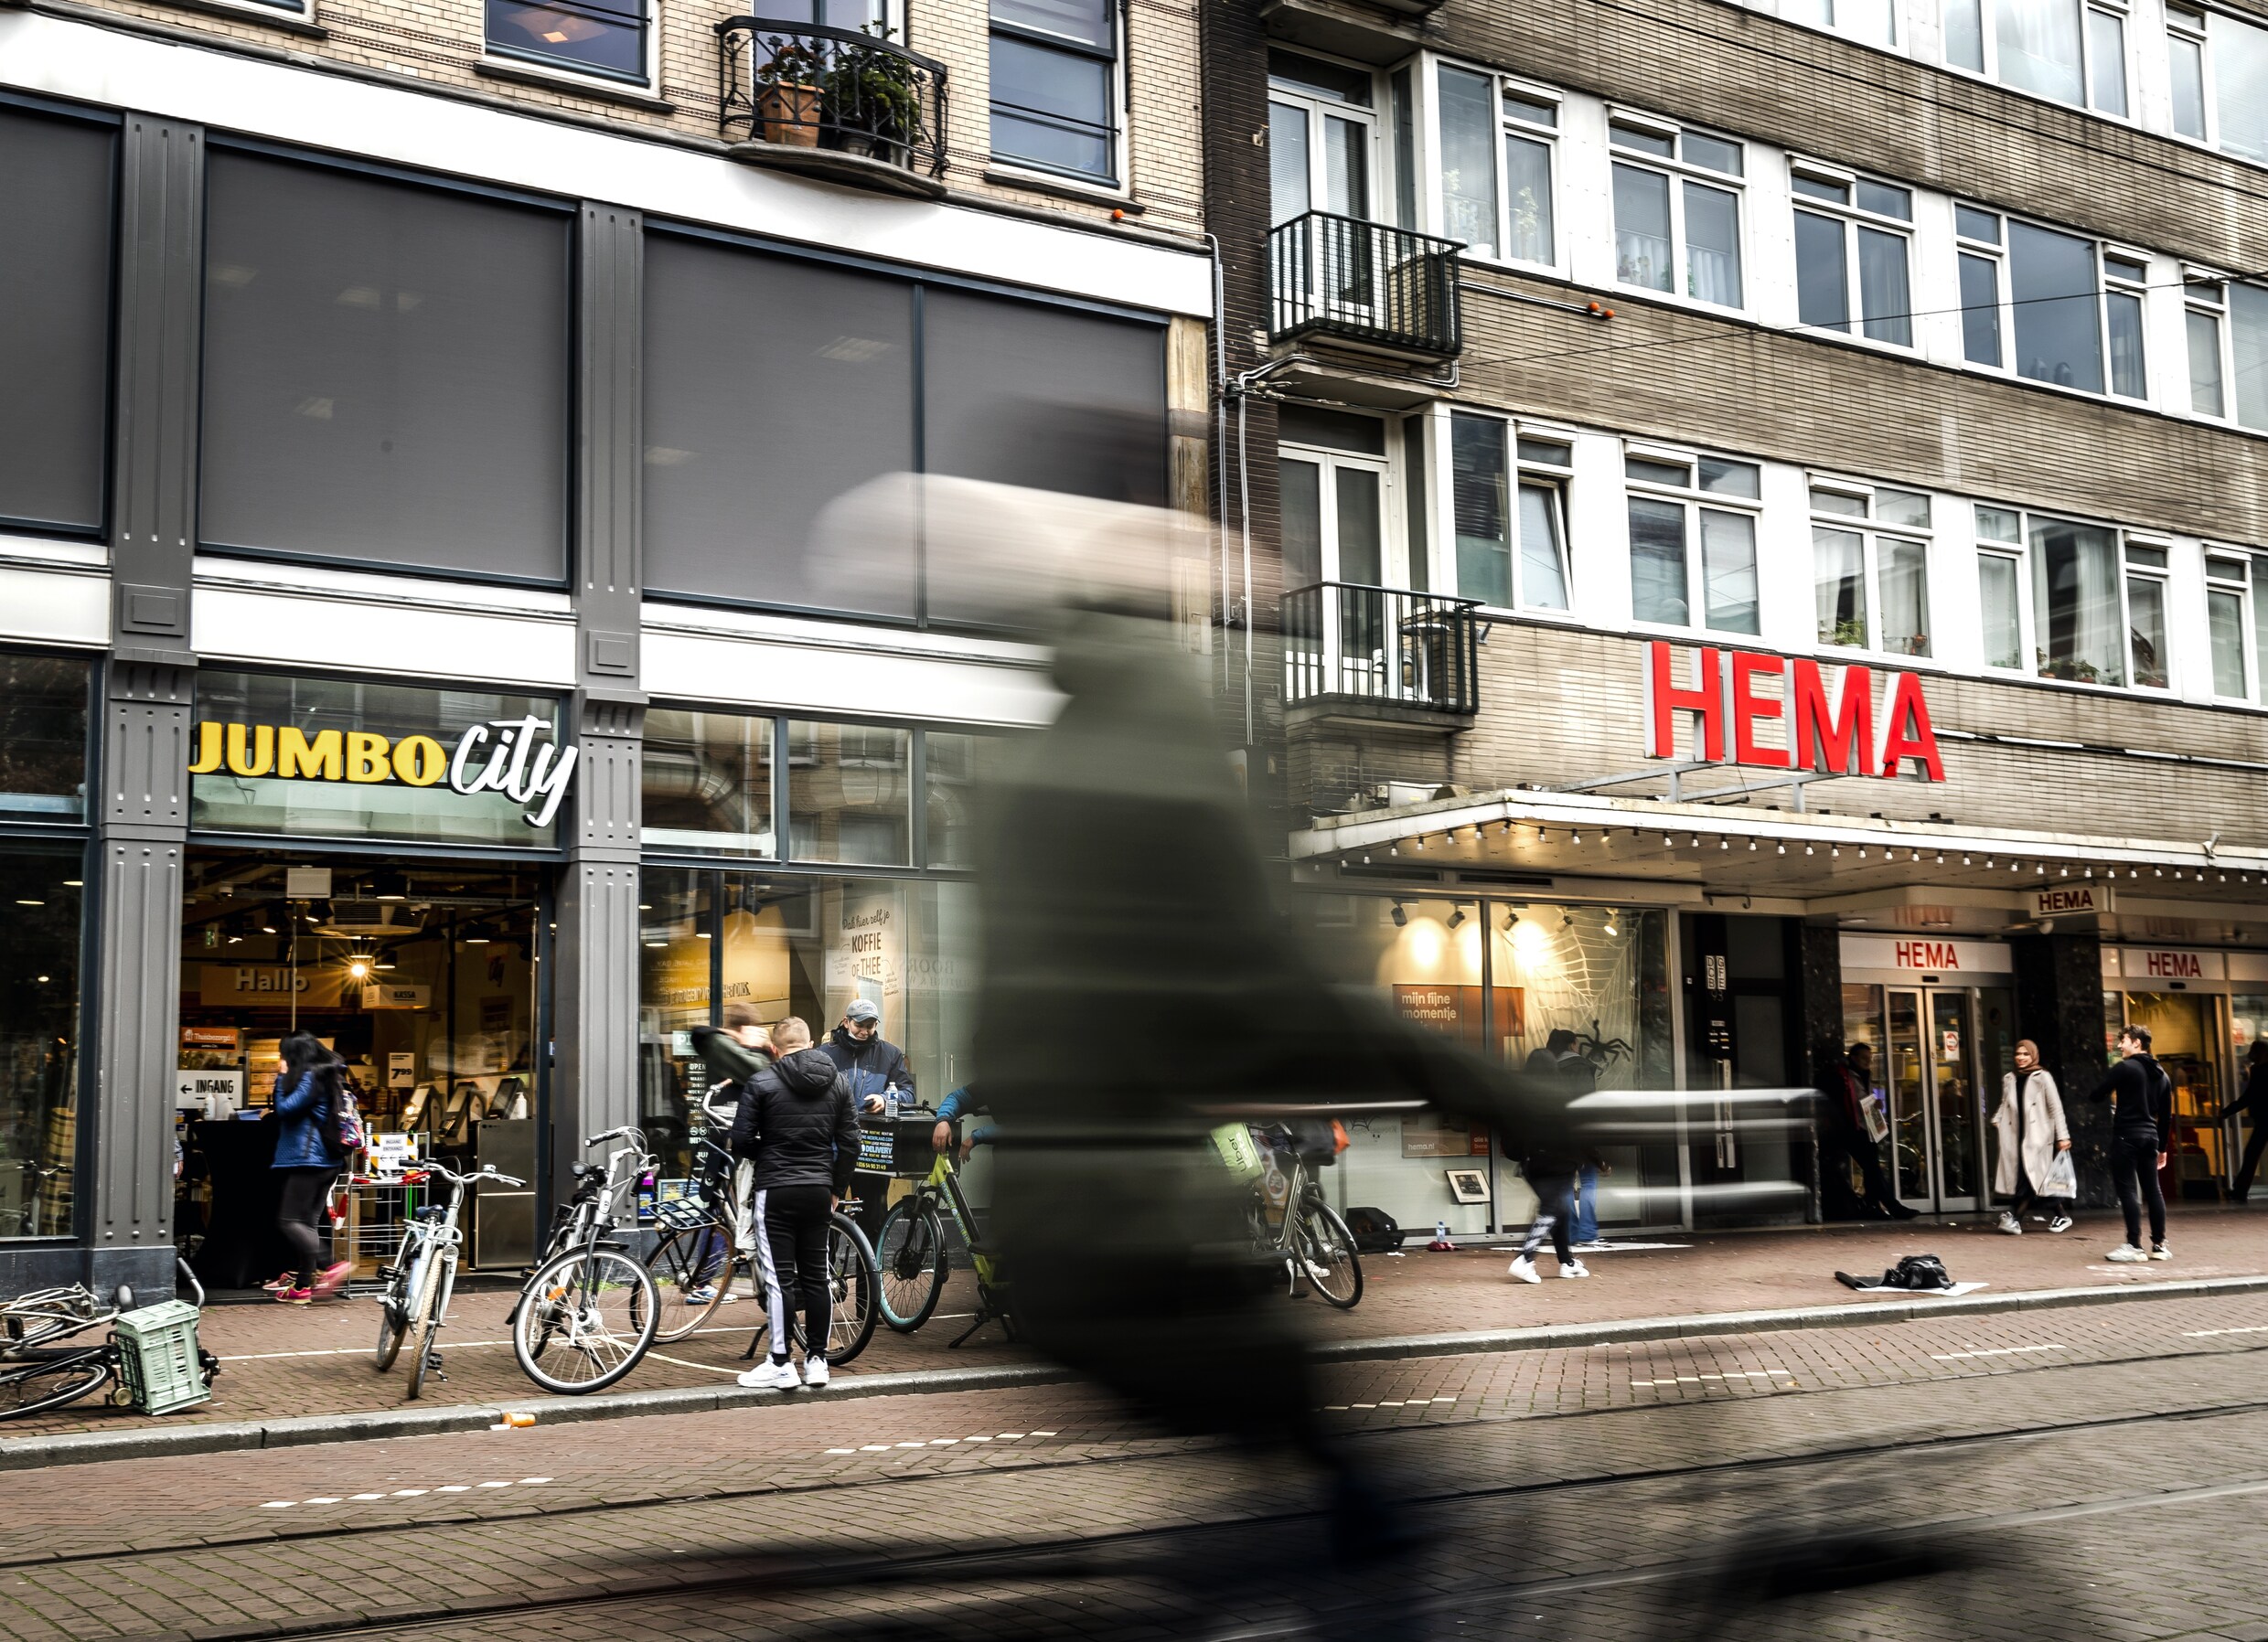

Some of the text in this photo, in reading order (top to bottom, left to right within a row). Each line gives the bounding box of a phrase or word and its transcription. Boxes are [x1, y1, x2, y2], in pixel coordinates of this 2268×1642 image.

[1642, 640, 1946, 783] HEMA
[187, 714, 579, 828] JUMBO City
[2038, 889, 2094, 912] HEMA
[856, 915, 869, 928] hier
[870, 909, 883, 925] zelf
[883, 910, 890, 924] je
[851, 932, 882, 954] KOFFIE
[861, 956, 881, 976] THEE
[1896, 941, 1960, 970] HEMA
[2146, 951, 2202, 978] HEMA
[235, 968, 310, 992] Hallo
[394, 990, 417, 999] KASSA
[1402, 992, 1450, 1007] mijn fijne
[1402, 1007, 1457, 1021] momentje
[195, 1079, 234, 1093] INGANG
[865, 1145, 893, 1155] DELIVERY
